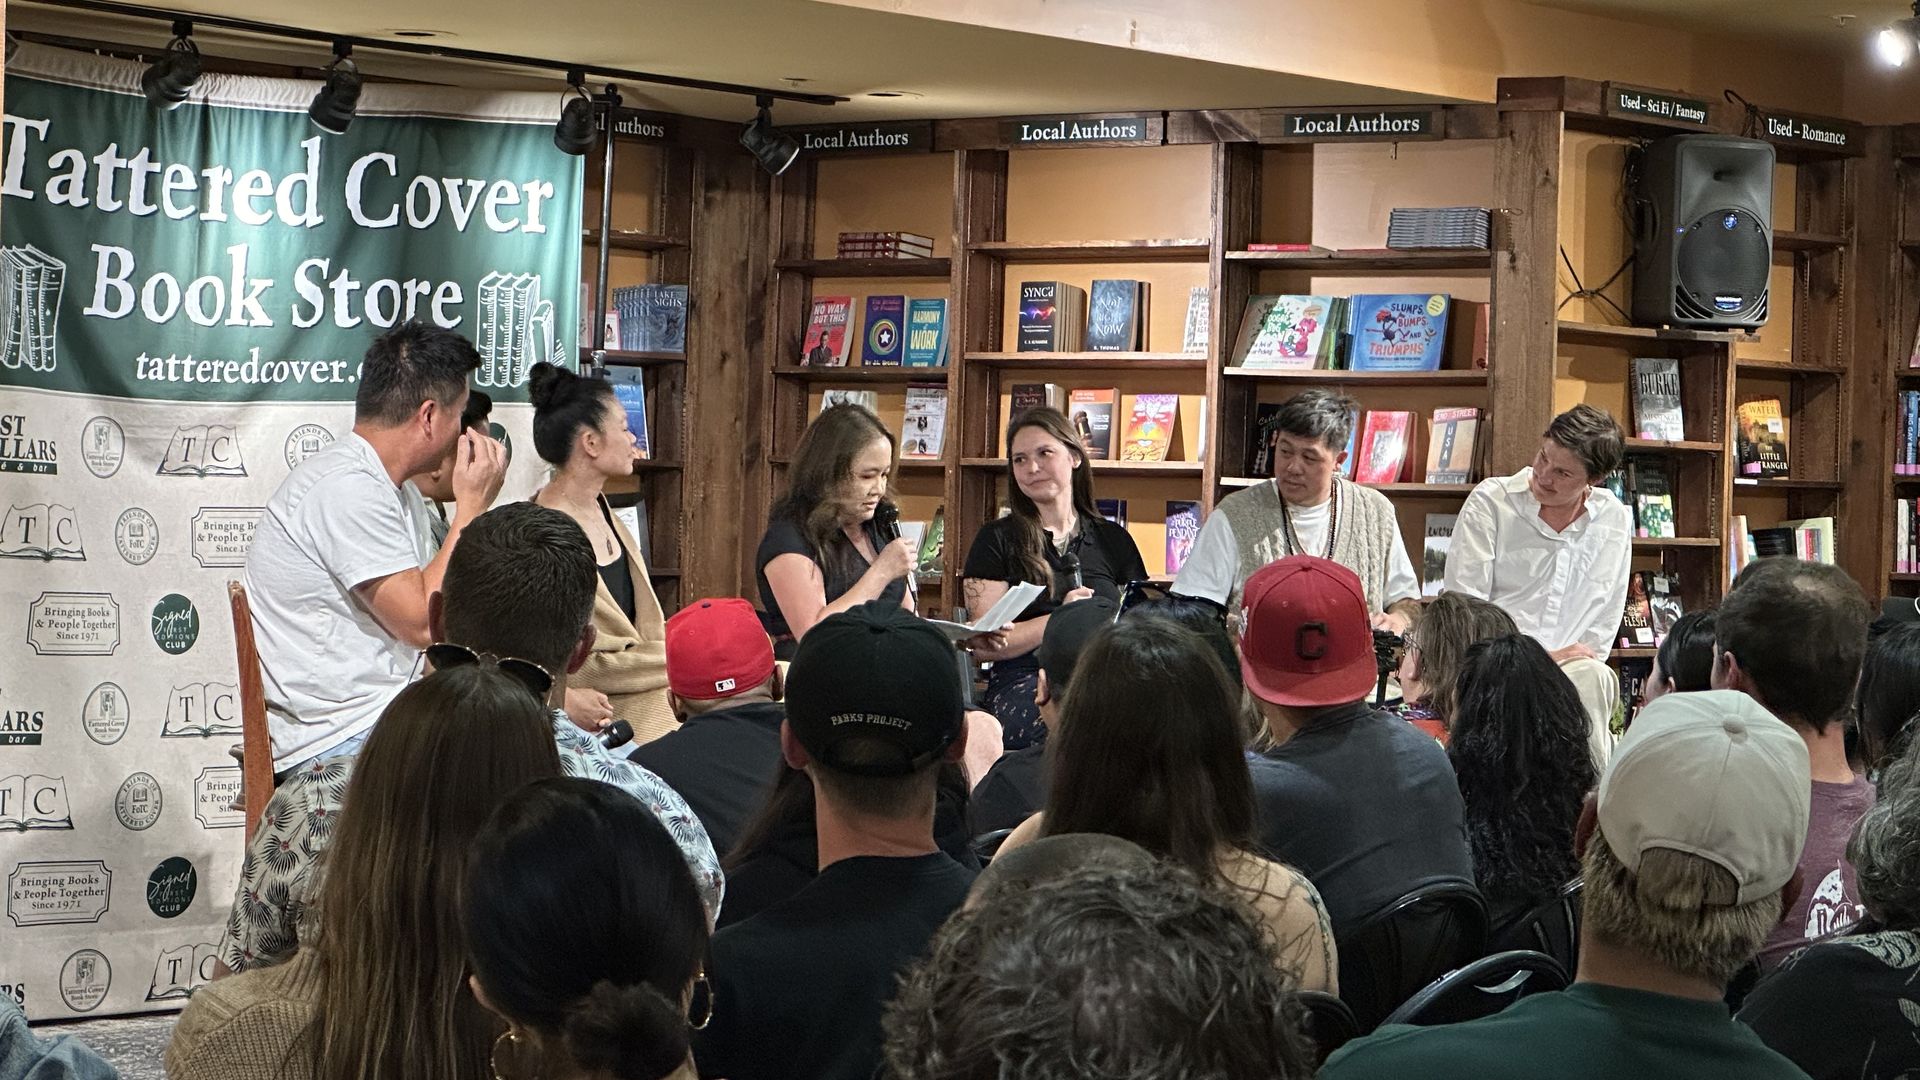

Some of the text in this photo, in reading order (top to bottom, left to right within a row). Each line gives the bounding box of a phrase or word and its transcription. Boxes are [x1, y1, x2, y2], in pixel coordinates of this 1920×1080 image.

[1620, 94, 1641, 110] Used
[1647, 98, 1660, 113] Sci
[1661, 101, 1670, 115] Fi
[1675, 103, 1706, 124] Fantasy
[1021, 119, 1137, 141] Local Authors
[1293, 112, 1421, 134] Local Authors
[1768, 118, 1793, 137] Used
[1801, 123, 1846, 145] Romance
[803, 130, 909, 150] Local Authors
[2, 113, 554, 234] Tattered Cover
[83, 243, 464, 330] Book Store
[814, 303, 846, 315] NO WAY
[814, 313, 846, 324] BUT THIS
[910, 329, 939, 350] WORK
[1369, 342, 1425, 356] TRIUMPHS
[1640, 372, 1679, 395] BURKE
[181, 436, 230, 462] T C
[1760, 452, 1780, 461] LITTLE
[17, 463, 24, 471] &
[32, 464, 48, 473] bar
[1754, 460, 1788, 470] TRANGER
[18, 516, 73, 545] T C
[203, 522, 245, 532] Bringing
[197, 534, 204, 542] &
[208, 532, 240, 543] People
[44, 607, 110, 618] Bringing Books
[152, 600, 194, 636] Signed
[35, 620, 116, 631] & People Together
[1623, 616, 1648, 627] FLESH
[56, 632, 99, 642] Since 1971
[1295, 620, 1329, 661] C
[165, 641, 186, 649] CLUB
[179, 694, 234, 722] T C
[831, 713, 912, 731] PARKS PROJECT
[8, 735, 26, 743] bar
[33, 787, 57, 814] C
[200, 794, 208, 803] &
[132, 804, 148, 814] FoTC
[20, 874, 99, 888] Bringing Books
[13, 888, 105, 901] & People Together
[32, 901, 81, 910] Since 1971
[160, 904, 181, 912] CLUB
[168, 958, 182, 985] T
